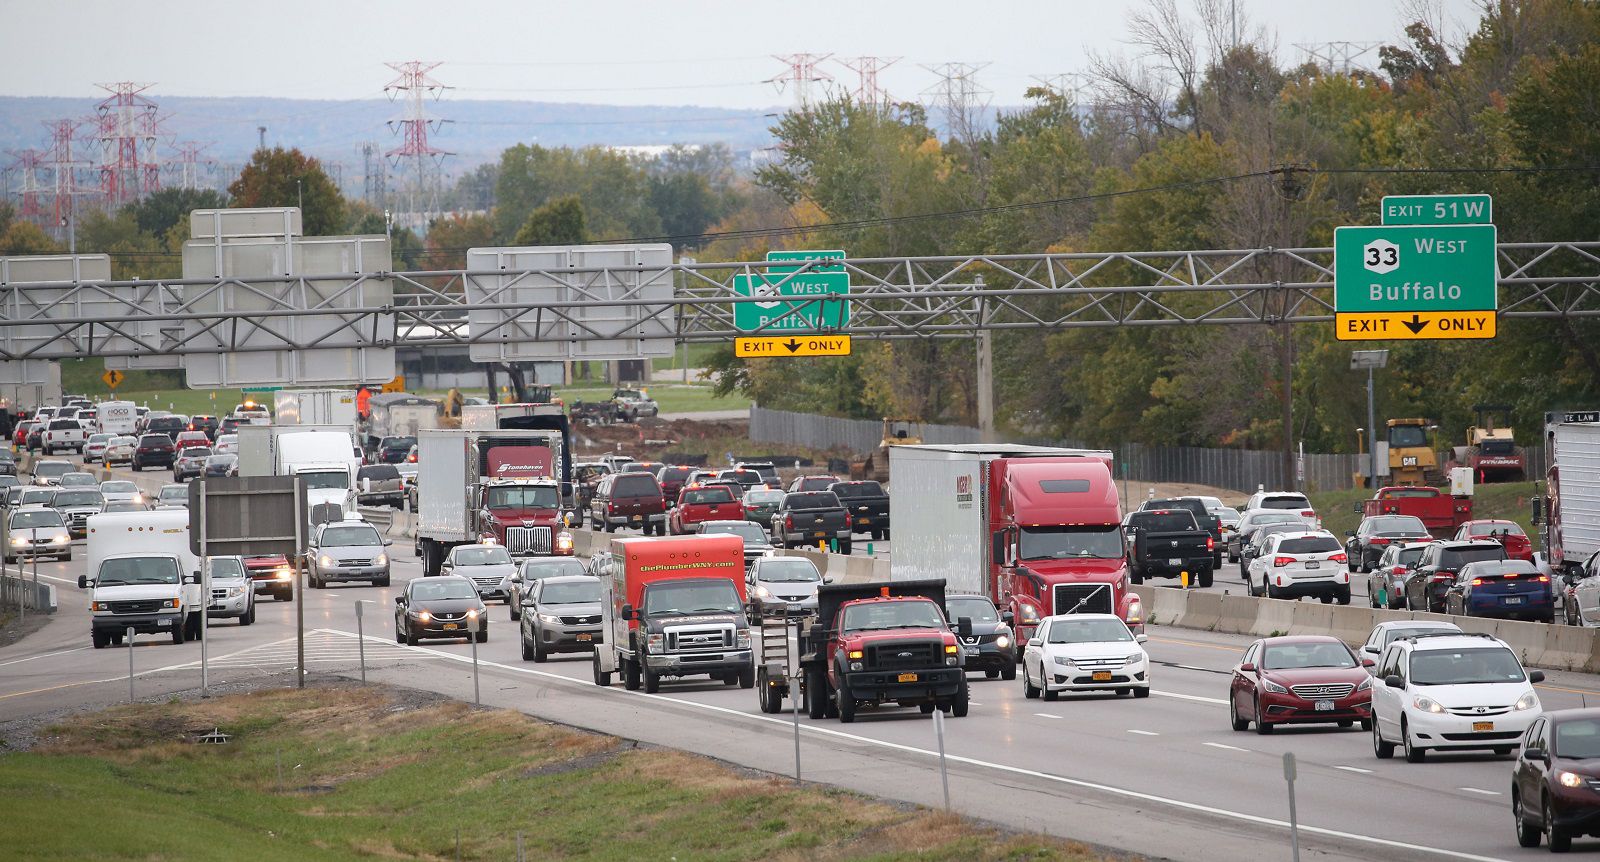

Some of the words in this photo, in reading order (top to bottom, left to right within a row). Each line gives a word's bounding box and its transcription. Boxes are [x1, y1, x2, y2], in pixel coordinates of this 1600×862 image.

[1388, 205, 1423, 217] EXIT
[1434, 201, 1484, 219] 51W
[1366, 247, 1398, 267] 33
[1369, 281, 1462, 301] Buffalo
[1348, 319, 1390, 332] EXIT
[1438, 317, 1487, 331] ONLY
[743, 342, 774, 352] EXIT
[808, 340, 843, 351] ONLY
[1578, 414, 1594, 422] LAW
[1403, 457, 1417, 466] CAT
[640, 561, 735, 573] thePlumberWNY.com
